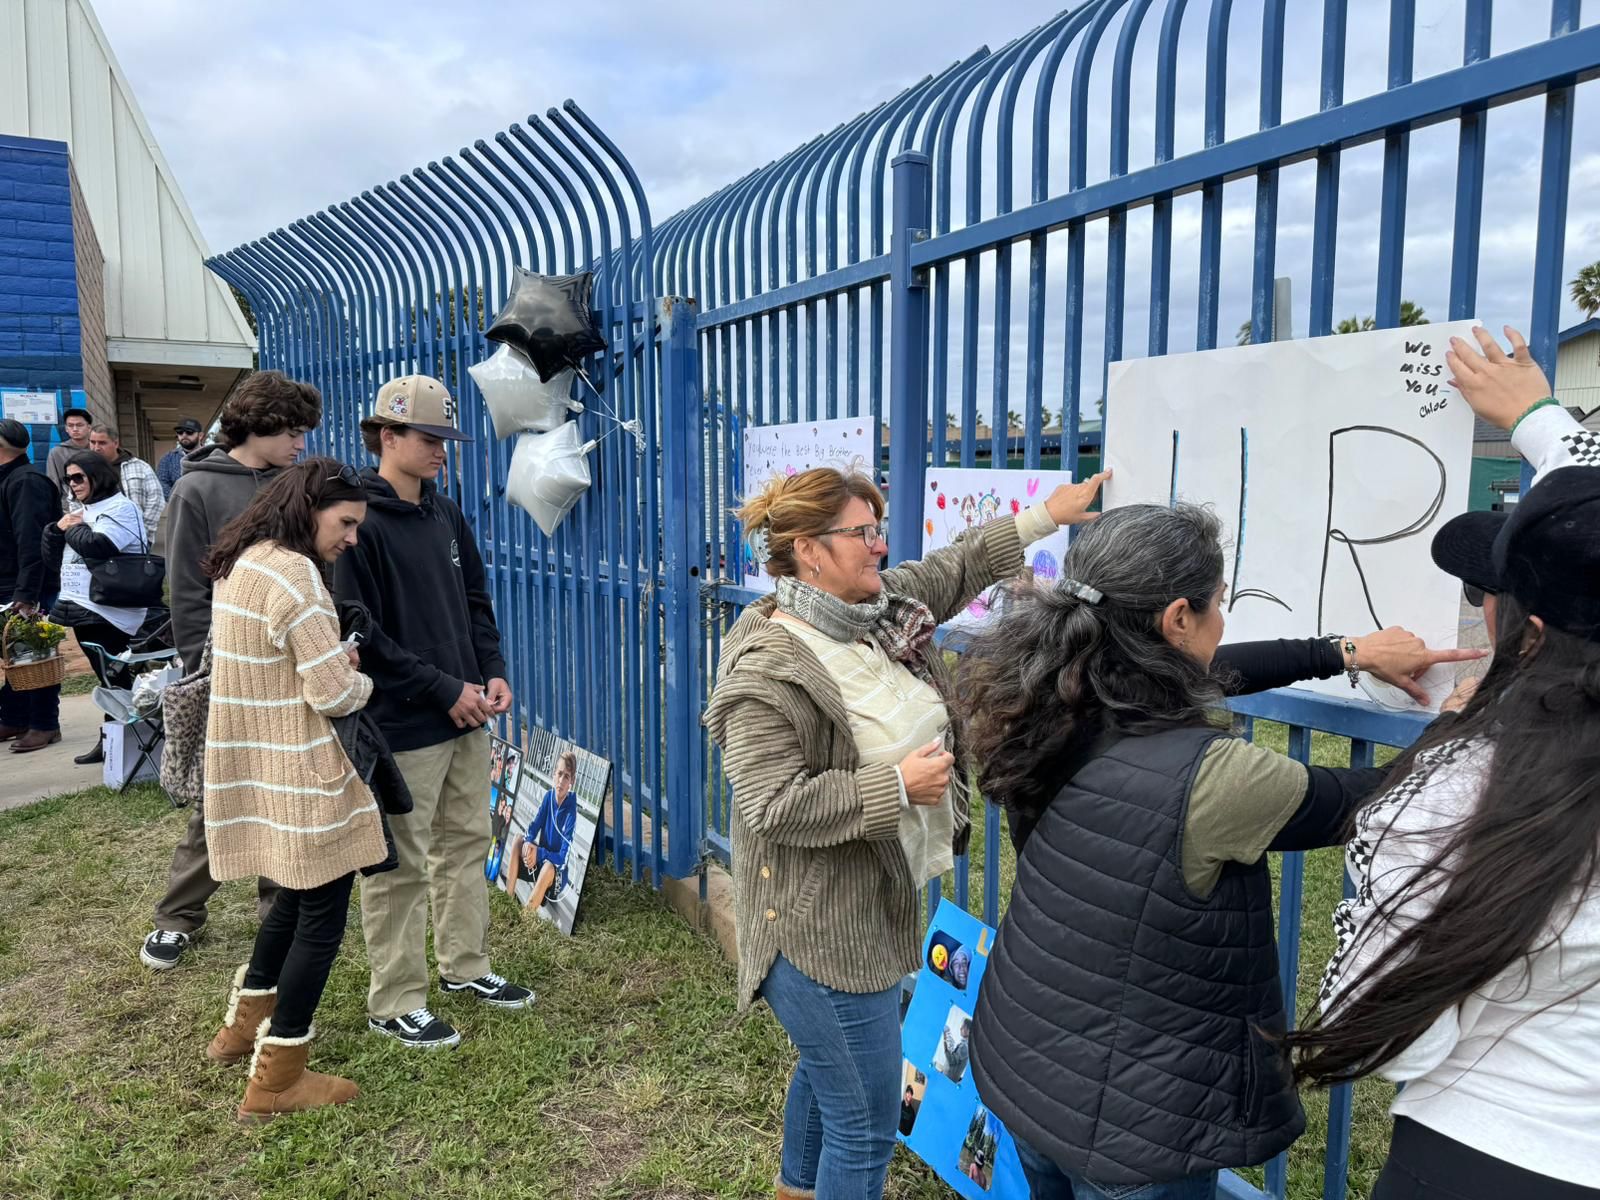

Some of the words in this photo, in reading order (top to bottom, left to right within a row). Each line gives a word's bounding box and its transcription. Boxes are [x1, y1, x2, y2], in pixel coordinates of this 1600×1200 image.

[1405, 341, 1432, 357] We
[1399, 363, 1443, 376] miss
[1405, 379, 1438, 396] You
